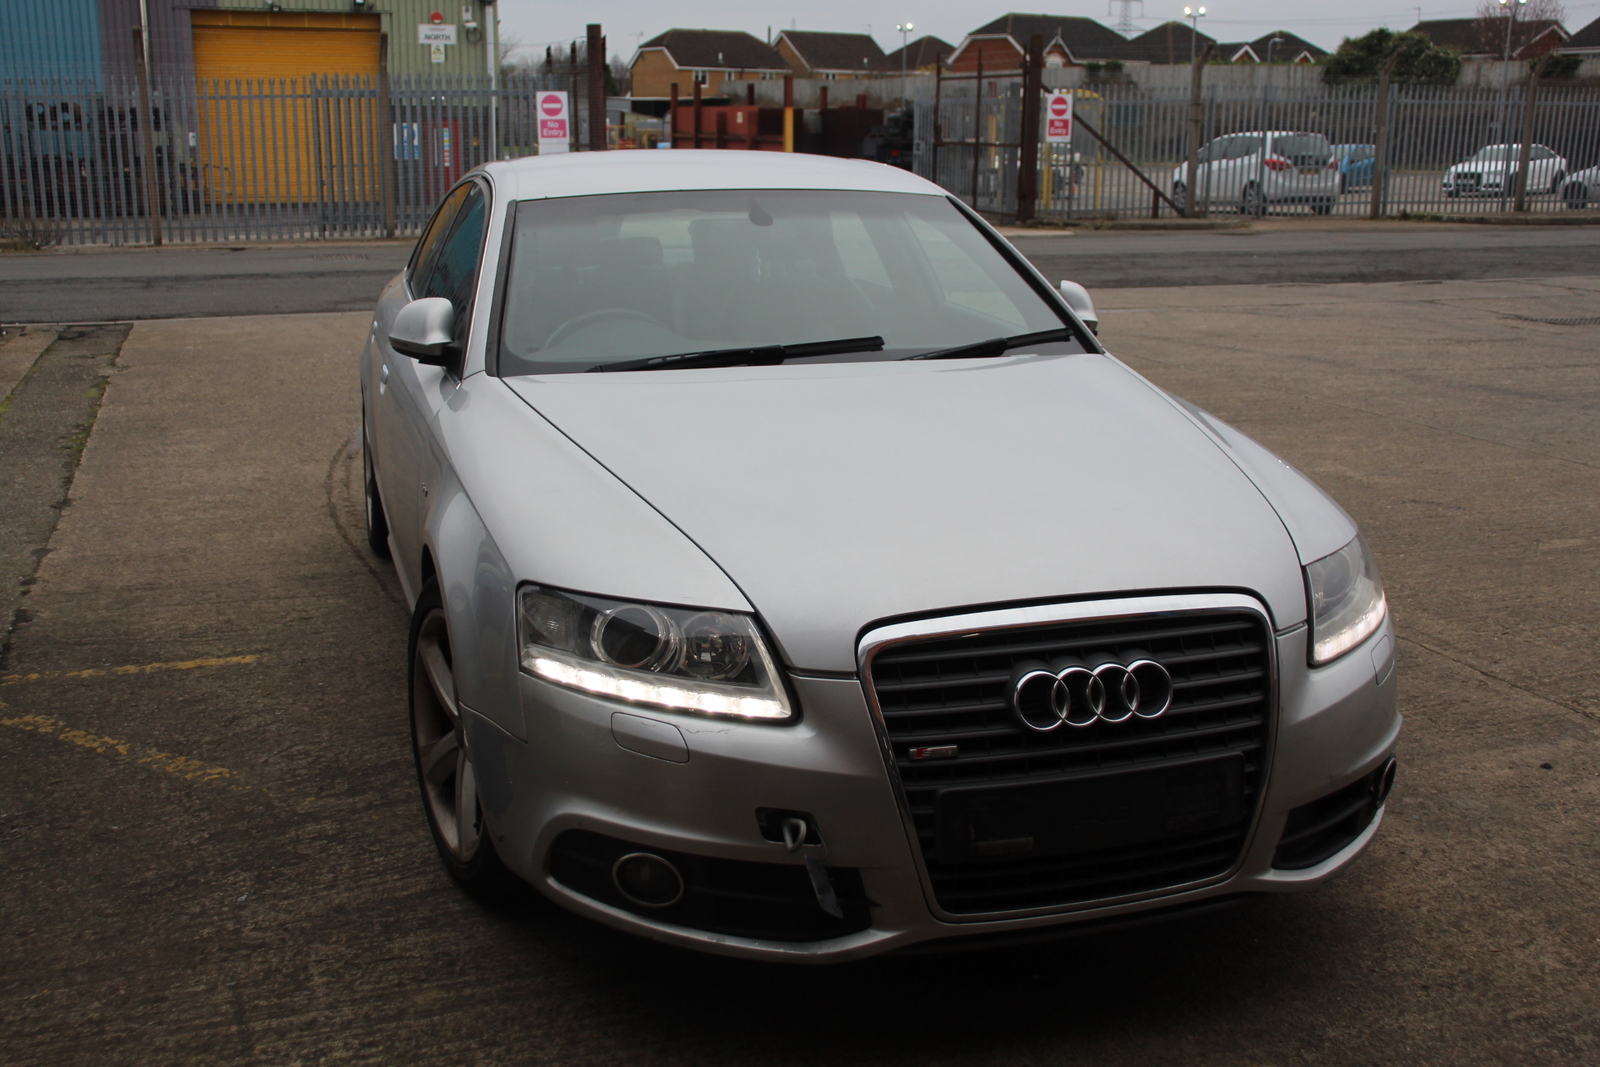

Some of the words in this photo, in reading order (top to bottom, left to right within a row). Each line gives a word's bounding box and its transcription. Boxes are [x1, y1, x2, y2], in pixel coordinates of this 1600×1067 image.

[424, 33, 451, 41] NORTH
[547, 120, 559, 128] No
[543, 128, 564, 137] Entry
[1050, 127, 1067, 135] Entry
